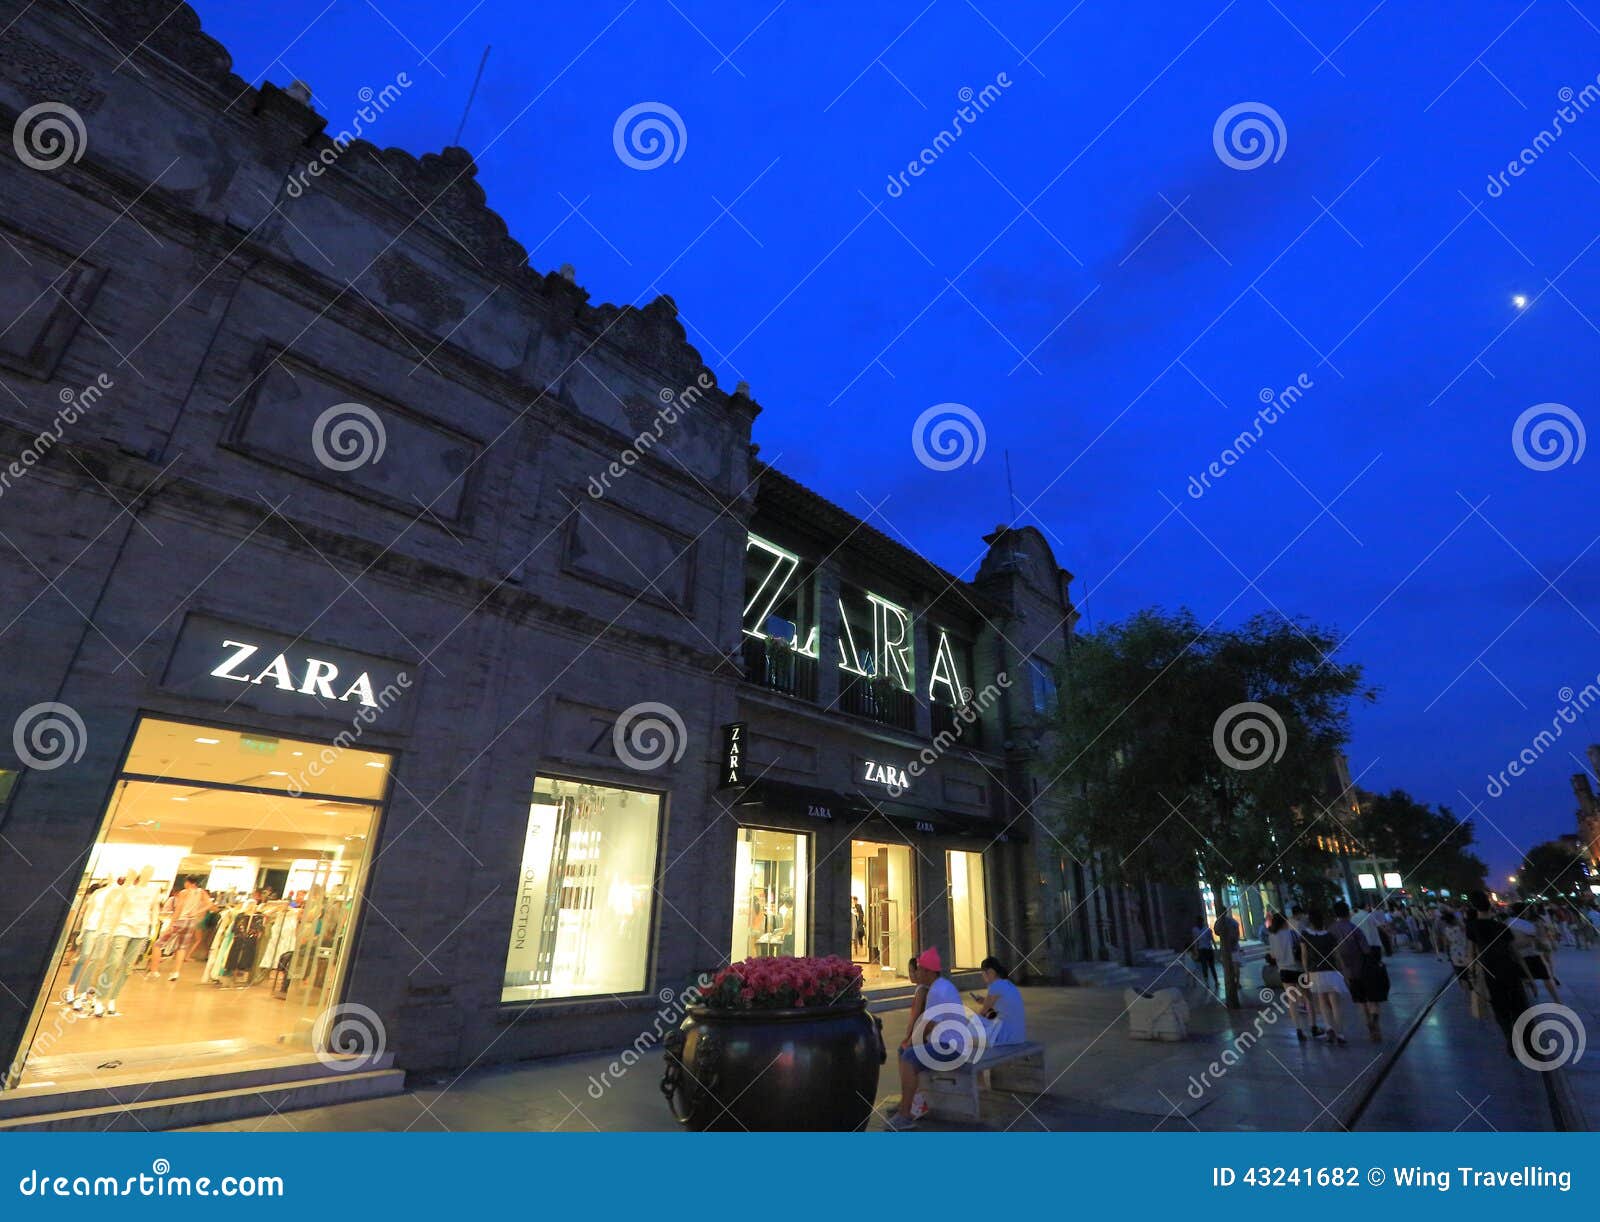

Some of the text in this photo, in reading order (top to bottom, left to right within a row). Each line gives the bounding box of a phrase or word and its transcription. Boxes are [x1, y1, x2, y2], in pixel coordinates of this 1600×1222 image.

[210, 639, 378, 708] ZARA
[728, 727, 740, 783] ZARA
[864, 761, 910, 789] ZARA
[515, 866, 535, 949] OLLECTION
